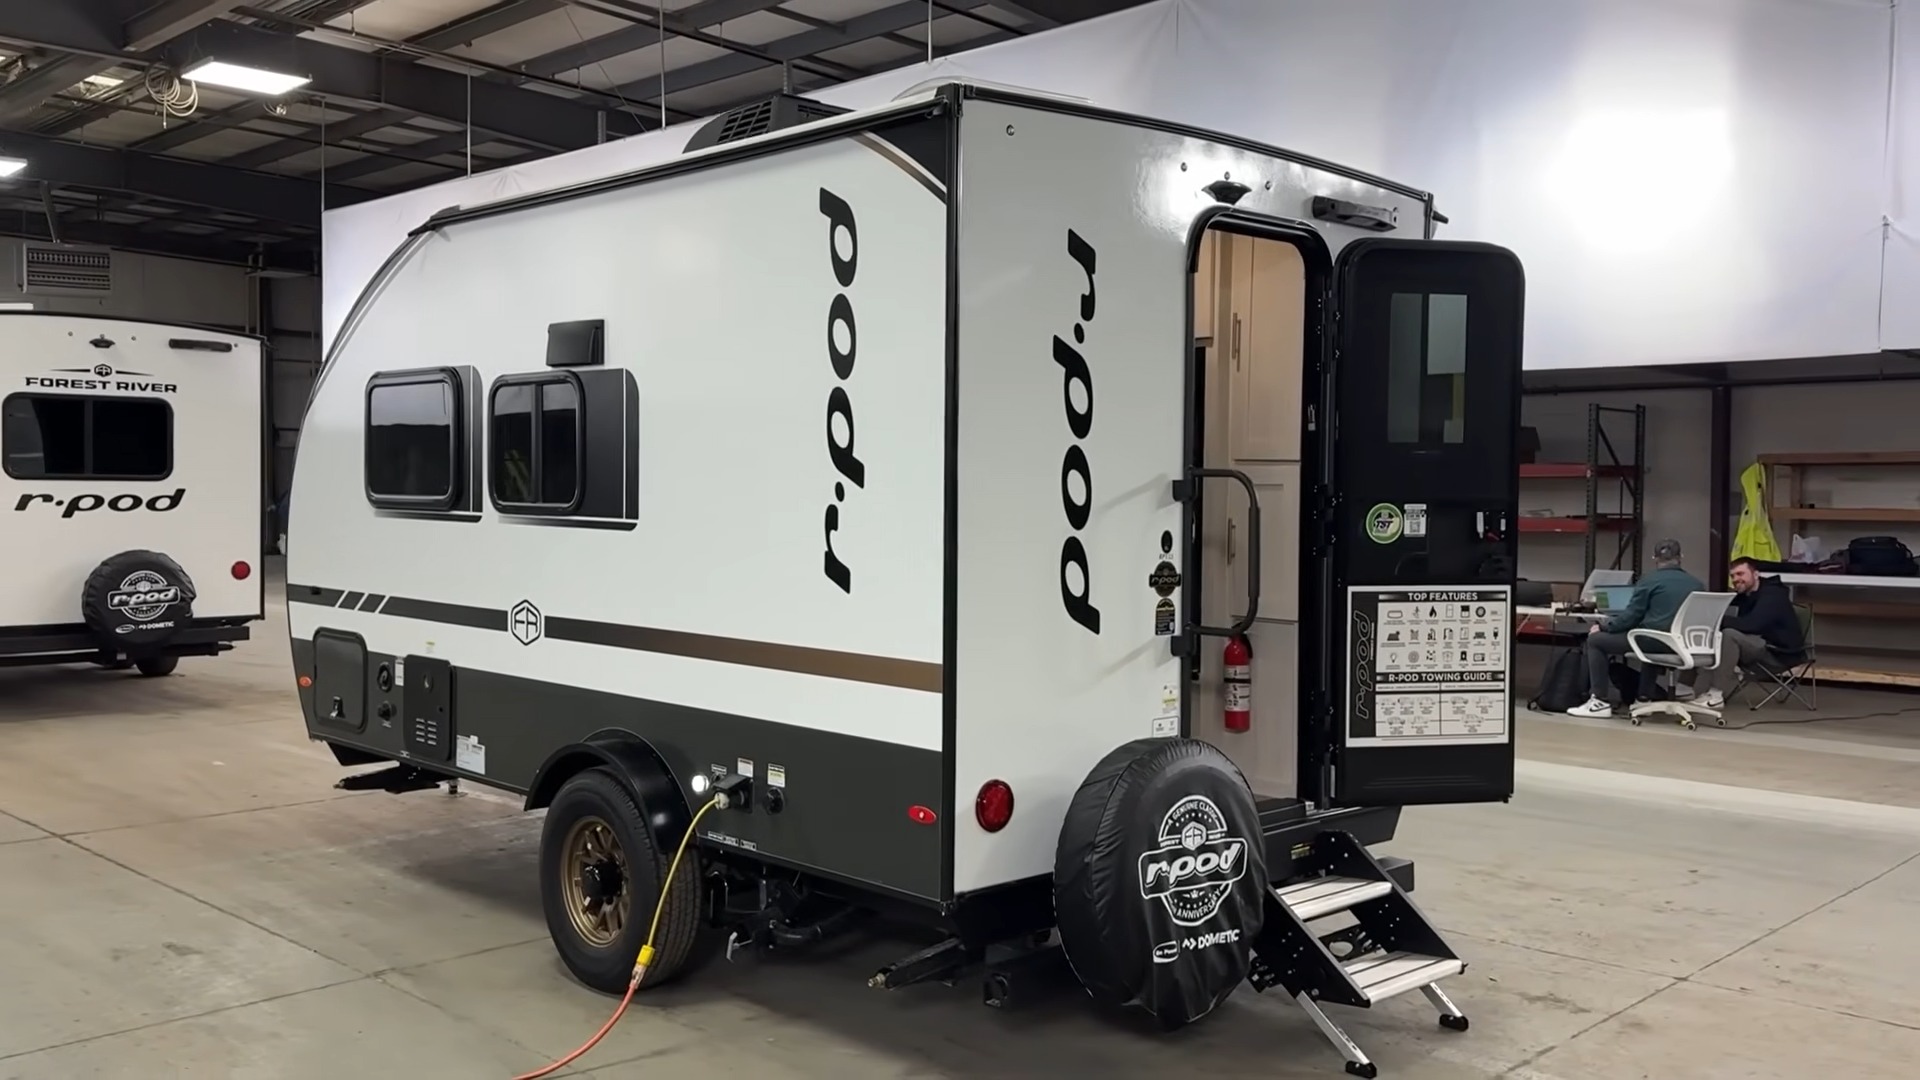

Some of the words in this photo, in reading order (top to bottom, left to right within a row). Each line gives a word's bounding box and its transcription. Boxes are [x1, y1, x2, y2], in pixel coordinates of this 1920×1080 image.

[25, 377, 111, 390] FOREST
[116, 381, 177, 393] RIVER
[1407, 592, 1427, 601] TOP
[1429, 592, 1478, 601] FEATURES
[147, 621, 174, 629] DOMETIC
[1421, 672, 1461, 681] TOWING
[1463, 672, 1493, 681] GUIDE
[1176, 888, 1221, 919] ANNIVERSARY
[1198, 929, 1240, 949] DOMETIC
